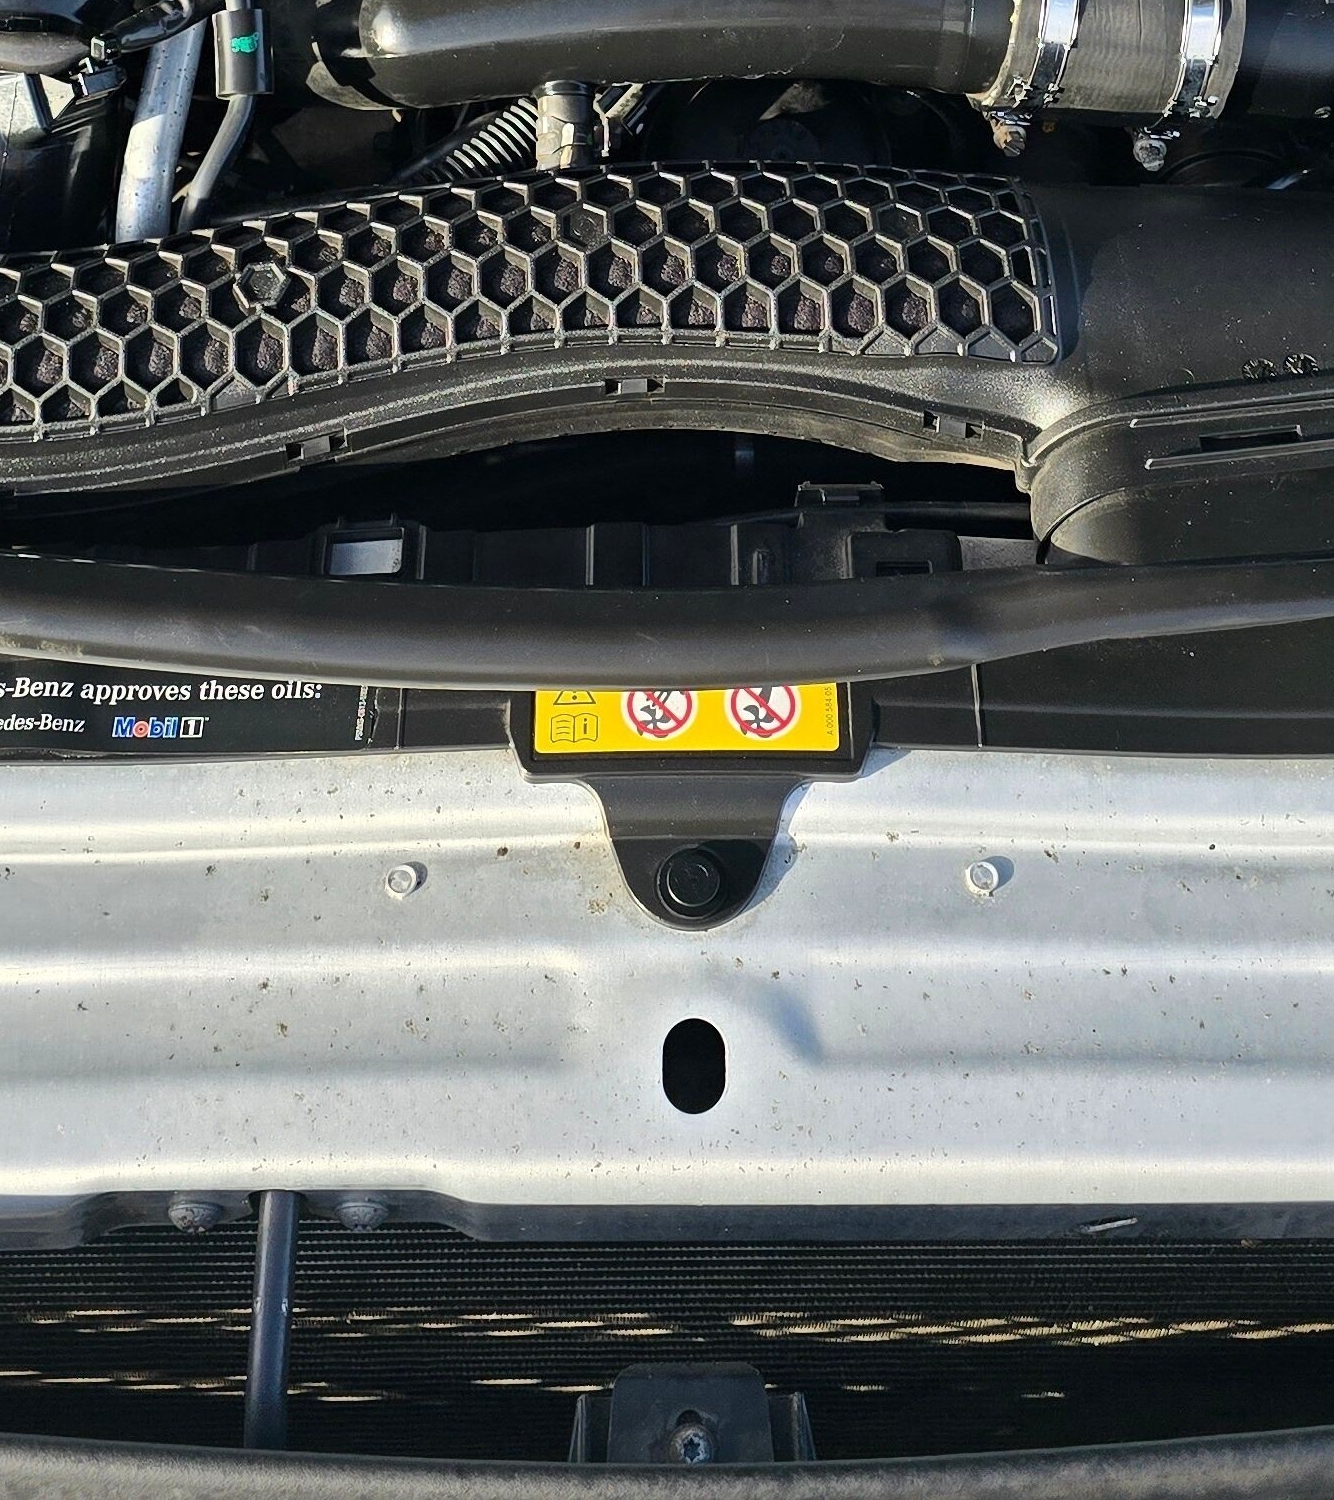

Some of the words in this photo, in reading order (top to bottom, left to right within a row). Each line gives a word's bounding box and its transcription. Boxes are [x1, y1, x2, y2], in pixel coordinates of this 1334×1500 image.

[80, 680, 192, 705] approves
[199, 680, 265, 700] these
[271, 680, 323, 700] oils:
[825, 698, 833, 712] 584
[111, 716, 180, 739] Mobil
[825, 713, 834, 729] 000
